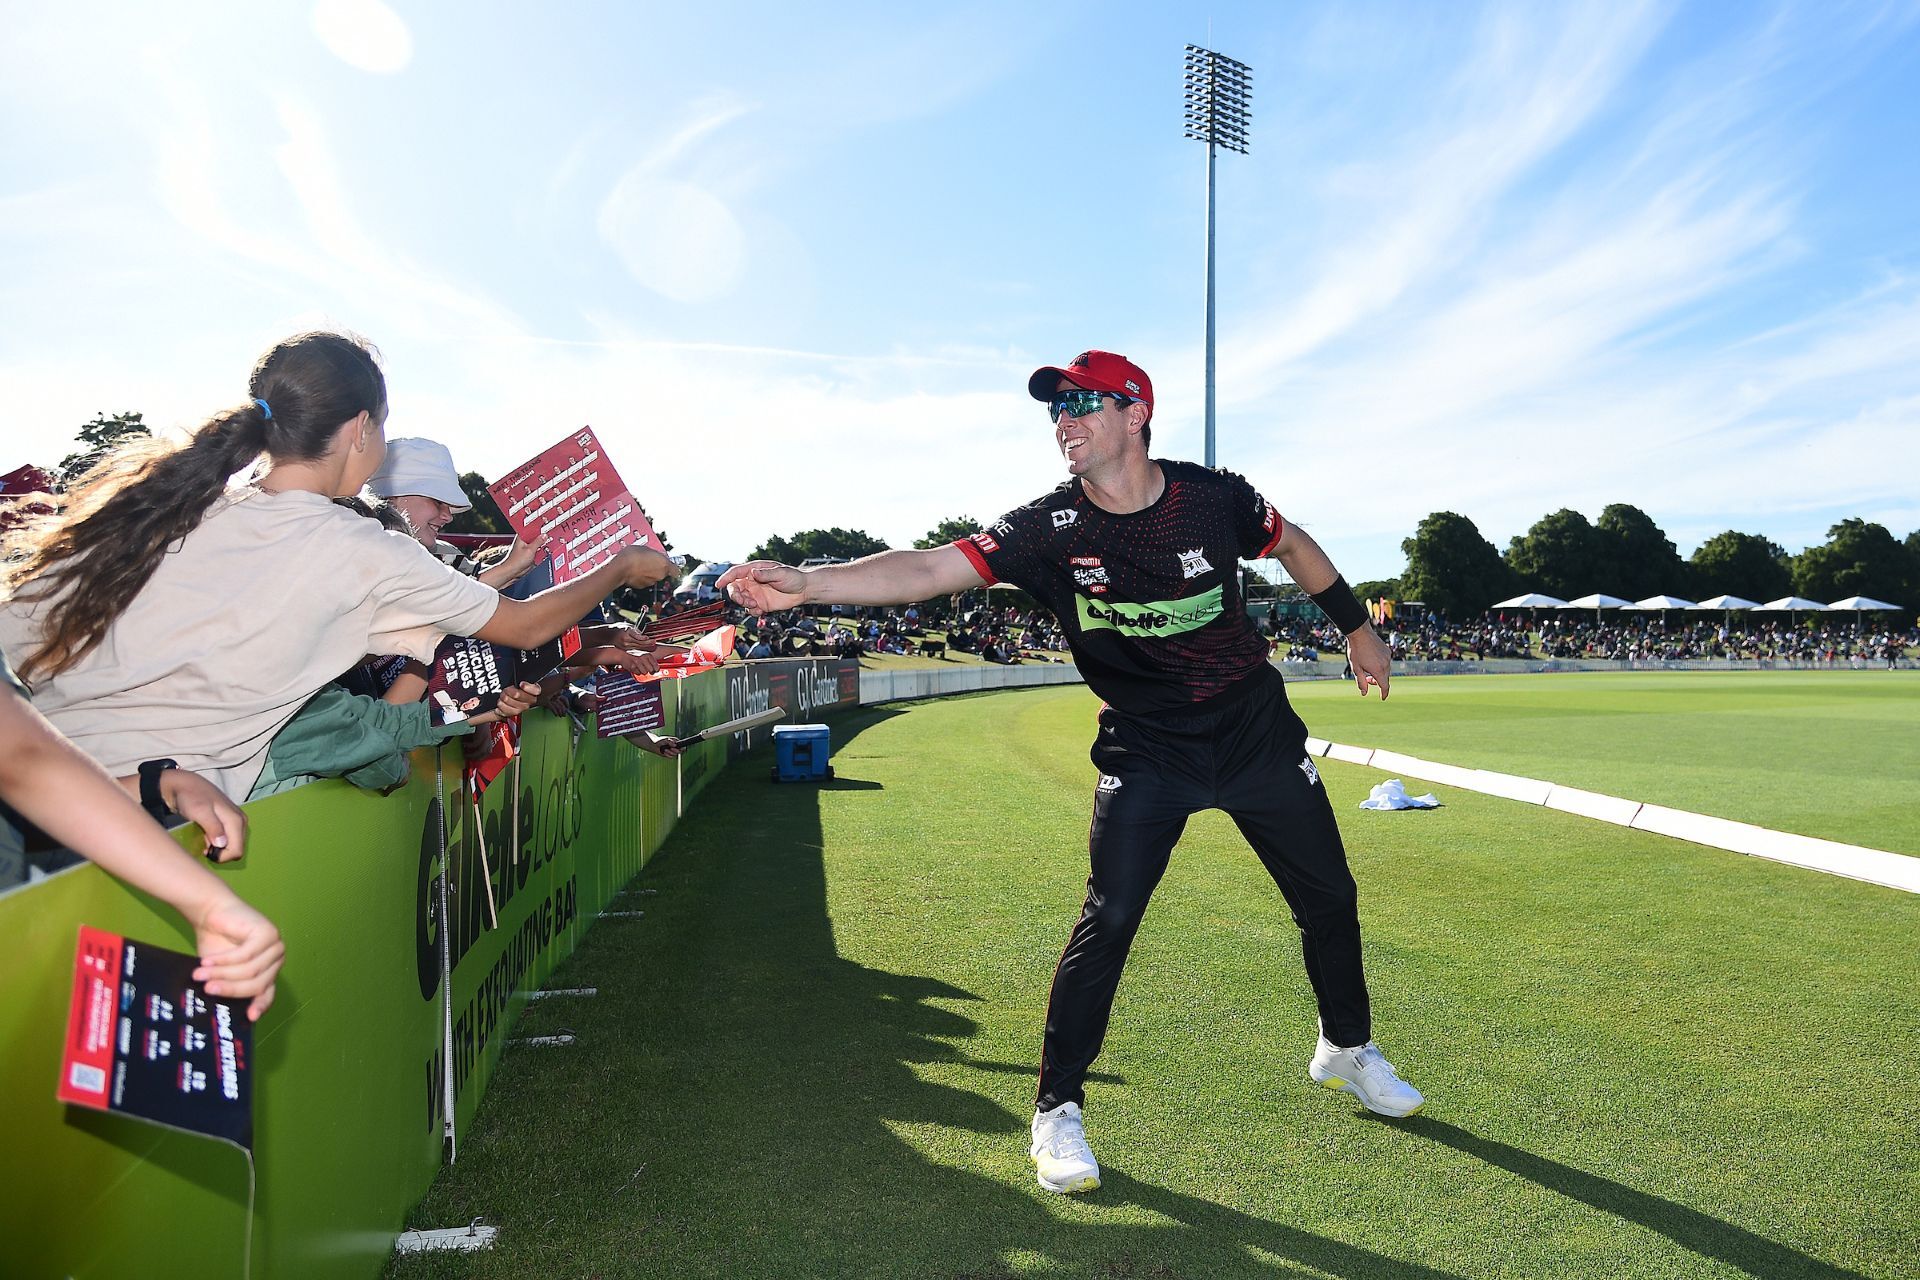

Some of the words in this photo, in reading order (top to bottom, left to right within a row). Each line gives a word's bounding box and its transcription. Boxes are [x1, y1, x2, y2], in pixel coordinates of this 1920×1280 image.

[379, 656, 408, 684] SUPER
[455, 650, 474, 689] KINGS
[465, 638, 490, 695] AGICIANS
[479, 640, 502, 694] TERBURY
[478, 895, 552, 1056] EXFOLIATING
[554, 874, 578, 938] BAR
